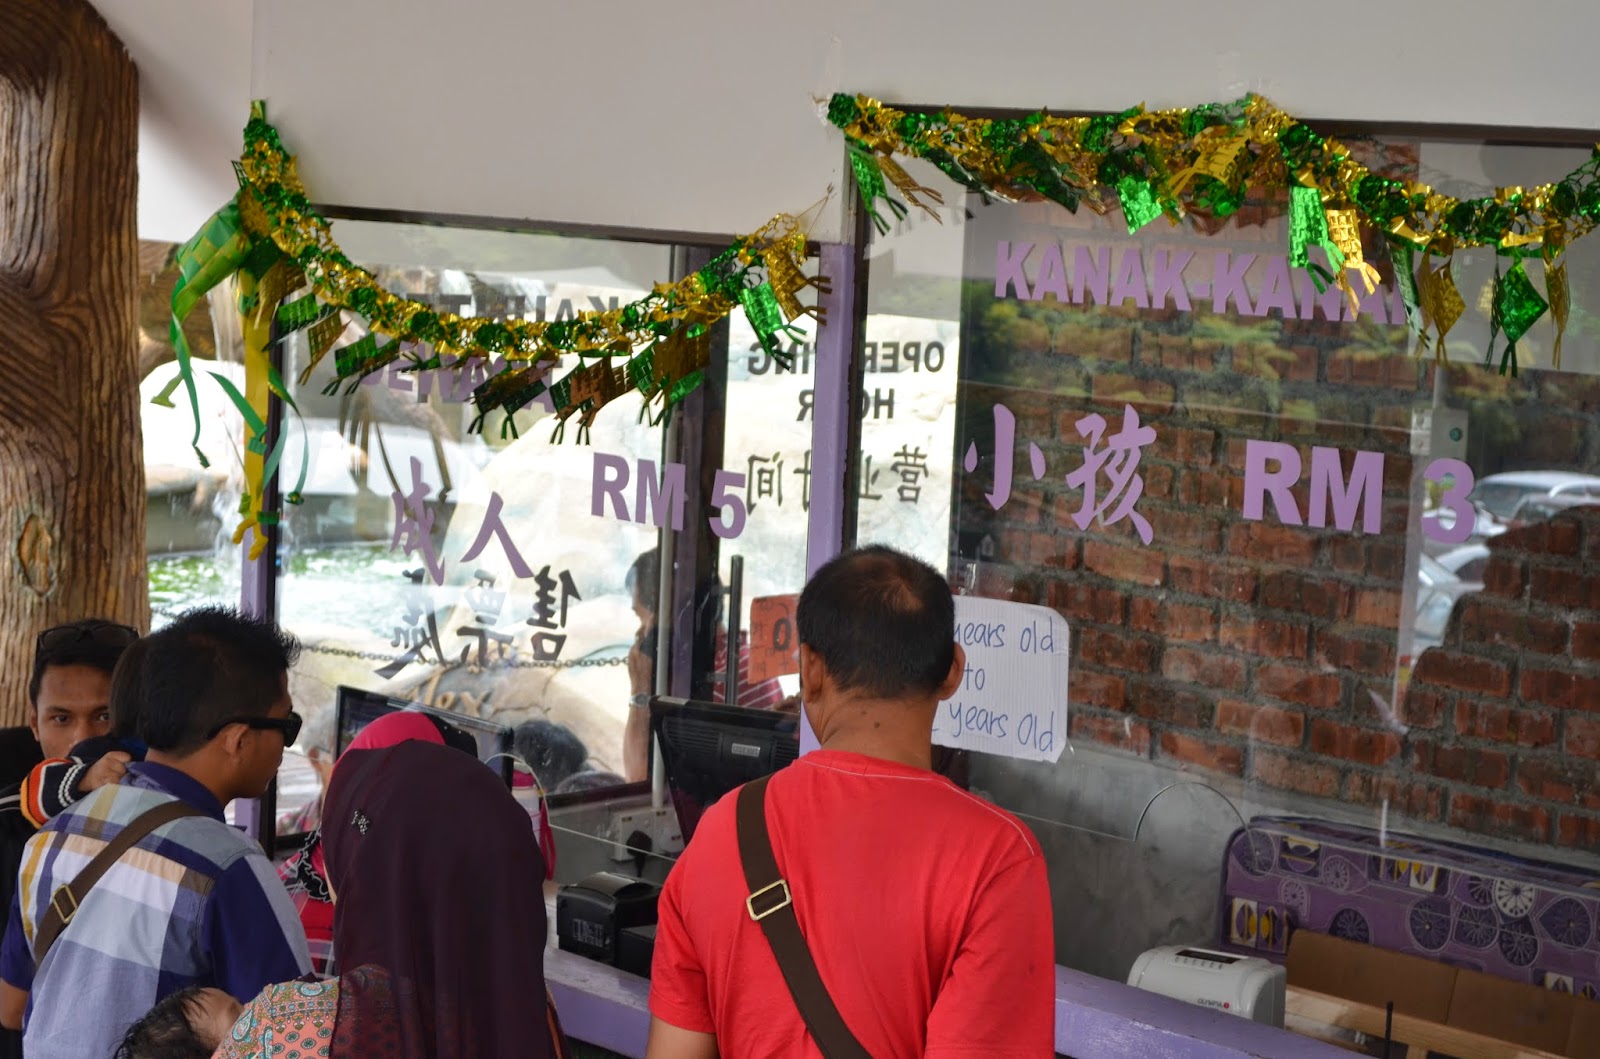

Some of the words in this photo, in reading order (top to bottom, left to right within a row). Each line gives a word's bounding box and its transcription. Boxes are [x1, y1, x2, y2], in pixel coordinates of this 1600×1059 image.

[964, 403, 1157, 547] 小孩
[1243, 439, 1385, 535] RM
[1421, 457, 1475, 544] 3
[390, 455, 534, 586] 成人
[591, 452, 686, 532] RM
[708, 468, 747, 540] 5
[964, 662, 986, 691] to
[949, 702, 1008, 738] years
